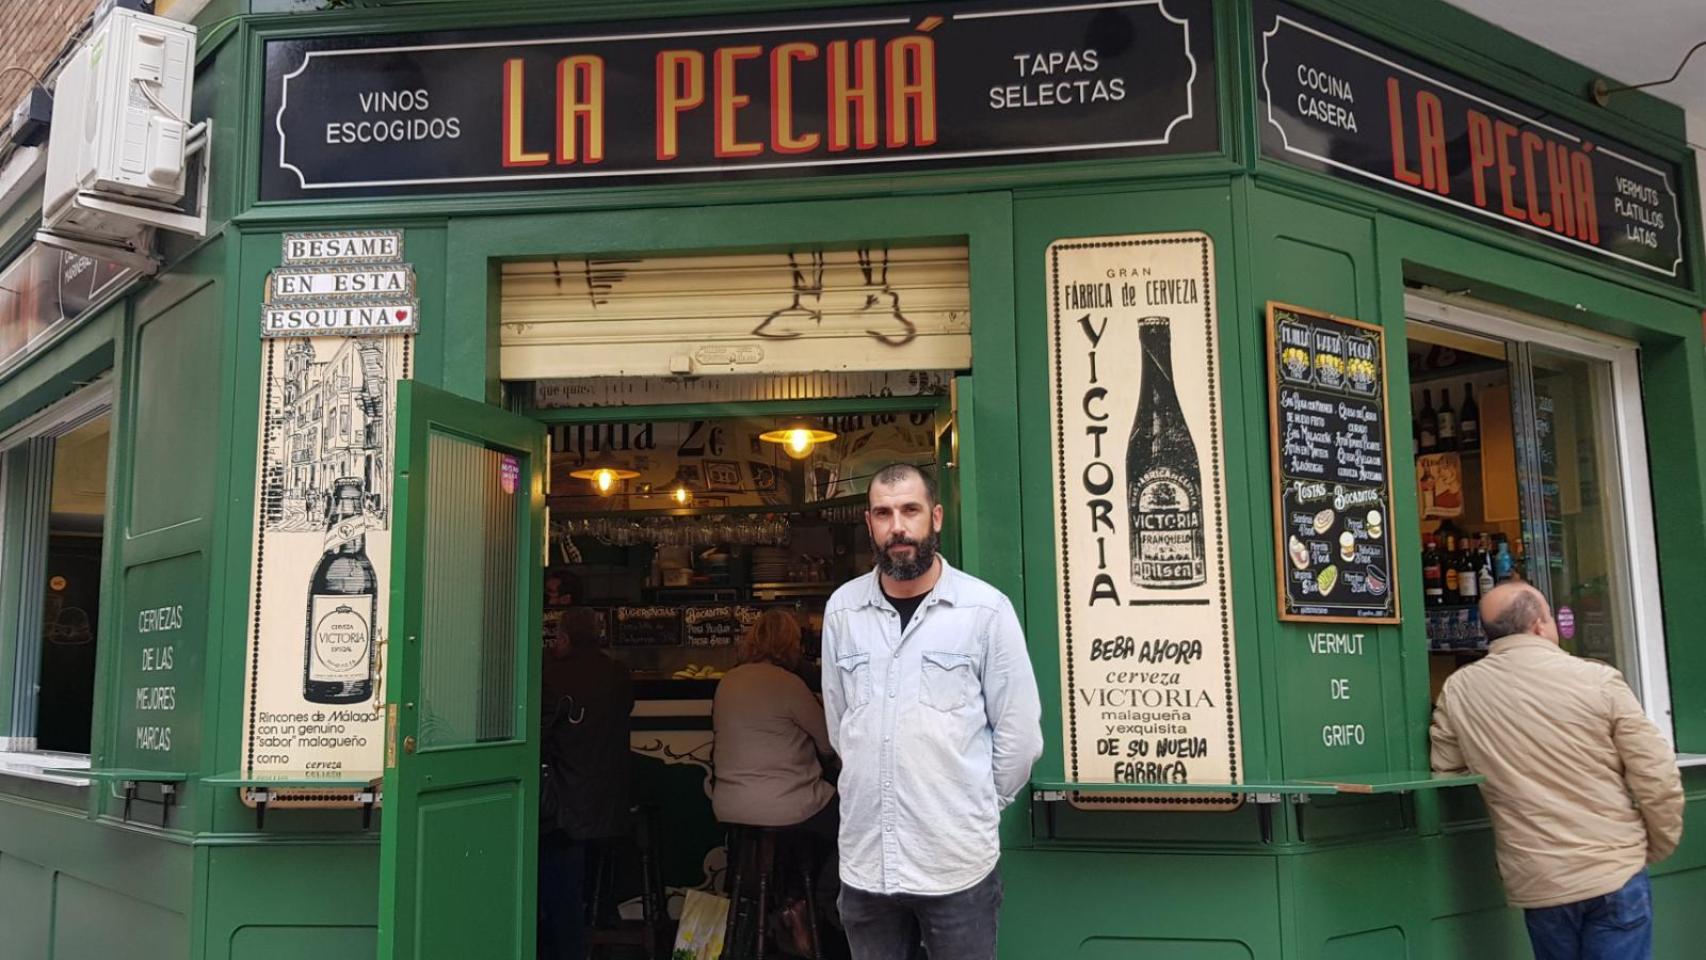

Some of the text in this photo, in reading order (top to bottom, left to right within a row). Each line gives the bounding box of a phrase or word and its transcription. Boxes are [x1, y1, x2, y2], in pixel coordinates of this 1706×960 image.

[1013, 49, 1100, 77] TAPAS
[502, 16, 944, 168] LA PECHÁ
[990, 79, 1126, 110] SELECTAS
[1297, 64, 1354, 104] COCINA
[359, 89, 430, 113] VINOS
[1297, 94, 1358, 134] CASERA
[326, 116, 461, 145] ESCOGIDOS
[1386, 77, 1600, 246] LA PECHÁ
[1615, 176, 1659, 208] VERMUTS
[1614, 197, 1665, 231] PLATILLOS
[1626, 223, 1658, 249] LATAS
[292, 238, 394, 258] BESAME
[281, 273, 402, 293] EN ESTA
[1106, 267, 1152, 278] GRAN
[1065, 279, 1198, 310] FÁBRICA de CERVEZA
[271, 309, 390, 329] ESQUINA
[1078, 312, 1121, 608] VICTORIA
[1132, 512, 1199, 528] VICTORIA
[138, 604, 183, 633] CERVEZAS
[319, 632, 366, 644] VICTORIA
[1090, 635, 1203, 664] BEBA AHORA
[1308, 633, 1365, 656] VERMUT
[142, 646, 173, 671] DE LAS
[1106, 670, 1181, 686] cerveza
[1331, 679, 1351, 700] DE
[136, 686, 175, 710] MEJORES
[1079, 688, 1216, 708] VICTORIA
[258, 712, 309, 723] Rincones
[311, 711, 326, 722] de
[1101, 709, 1192, 723] malagueña
[136, 727, 171, 752] MARCAS
[258, 723, 345, 736] con un genuino
[1321, 724, 1365, 747] GRIFO
[298, 736, 367, 749] malagueño
[1097, 737, 1207, 759] DE SU NUEVA
[256, 755, 289, 764] como
[305, 761, 342, 769] cerveza
